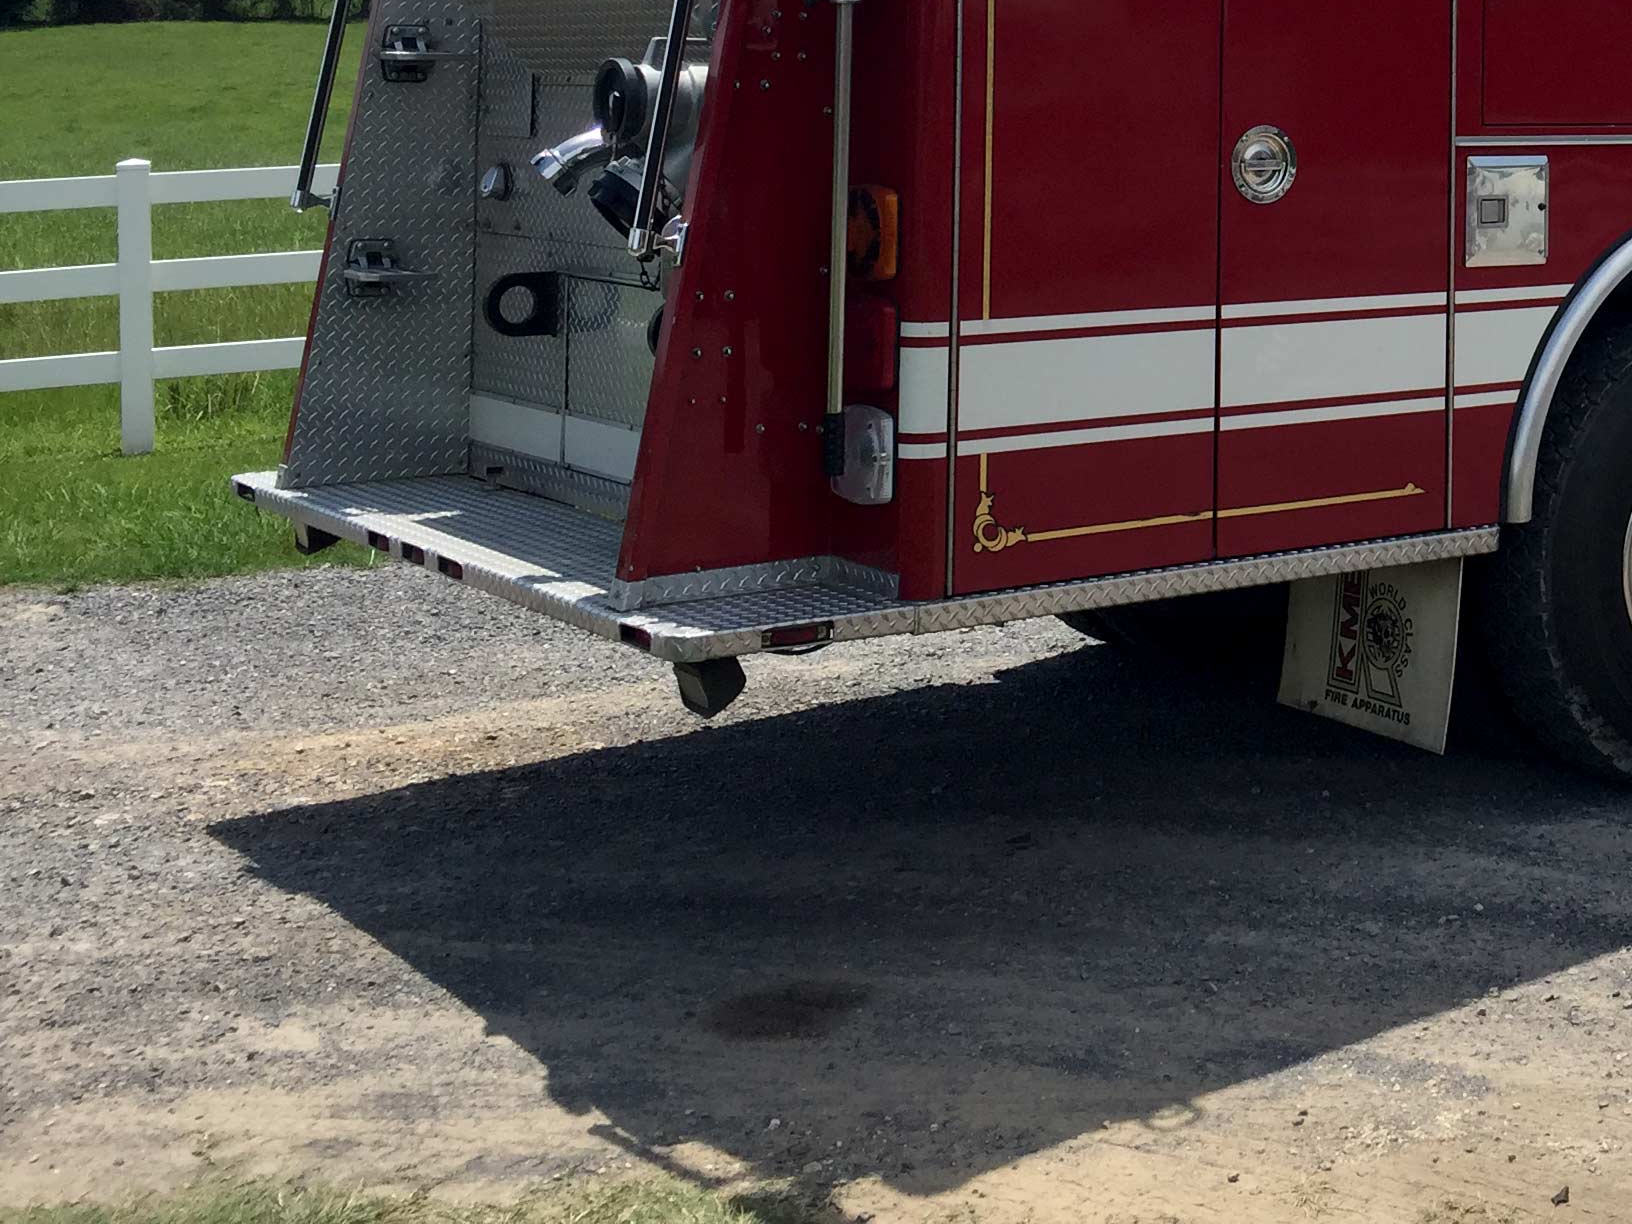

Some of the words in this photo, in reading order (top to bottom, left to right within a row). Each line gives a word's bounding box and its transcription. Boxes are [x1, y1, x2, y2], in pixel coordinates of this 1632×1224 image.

[1369, 582, 1407, 611] WORLD
[1395, 617, 1413, 678] CLASS
[1324, 689, 1348, 705] FIRE
[1351, 696, 1411, 726] APPARATUS
